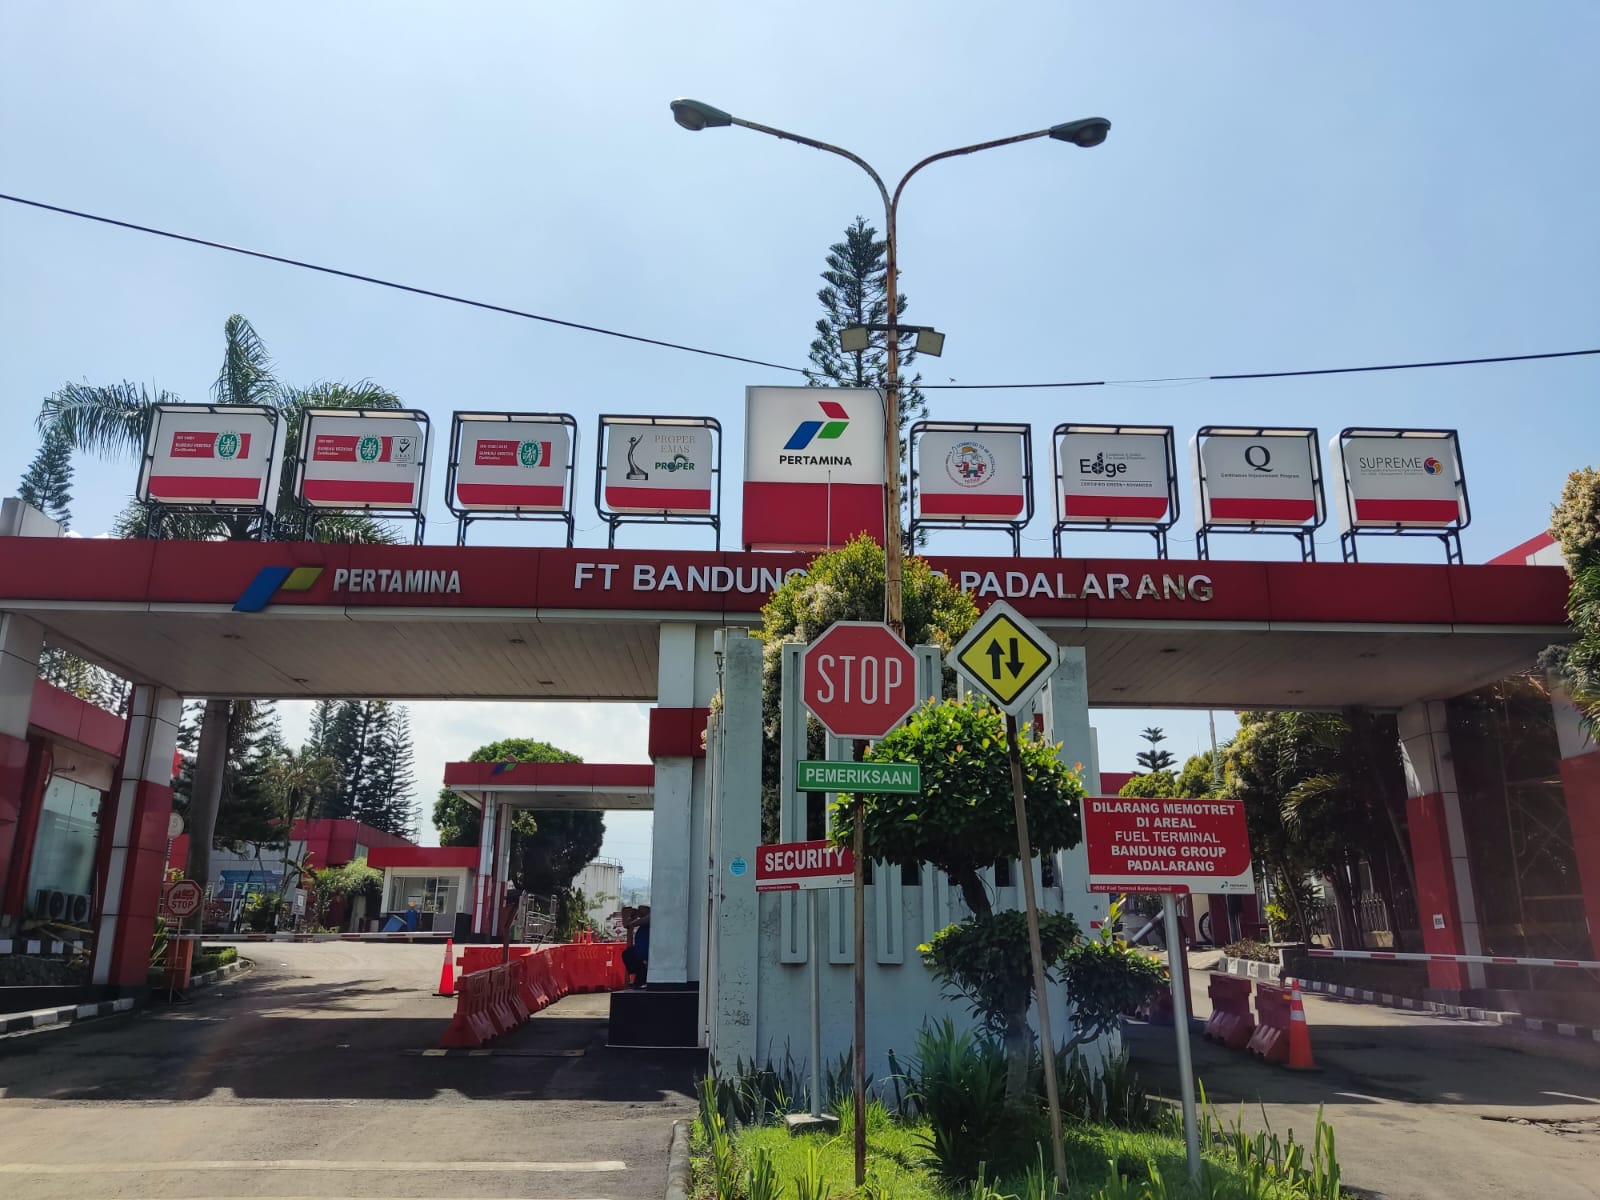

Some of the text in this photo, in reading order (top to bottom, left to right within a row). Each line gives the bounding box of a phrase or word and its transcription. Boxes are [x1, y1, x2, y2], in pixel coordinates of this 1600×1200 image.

[654, 435, 696, 443] PROPER
[661, 445, 690, 453] EMAS
[779, 455, 852, 466] PERTAMINA
[1244, 445, 1274, 473] Q
[1360, 457, 1422, 469] SUPREME
[655, 462, 695, 472] PROPER
[332, 568, 462, 593] PERTAMINA
[574, 562, 620, 590] FT
[959, 570, 1215, 602] PADALARANG
[817, 654, 903, 705] STOP
[806, 768, 912, 786] PEMERIKSAAN
[1092, 802, 1235, 816] DILARANG MEMOTRET
[1136, 817, 1197, 829] DI AREAL
[1115, 831, 1221, 844] FUEL TERMINAL
[1111, 845, 1227, 858] BANDUNG GROUP
[764, 848, 846, 872] SECURITY
[1127, 859, 1215, 872] PADALARANG
[171, 900, 194, 910] STOP
